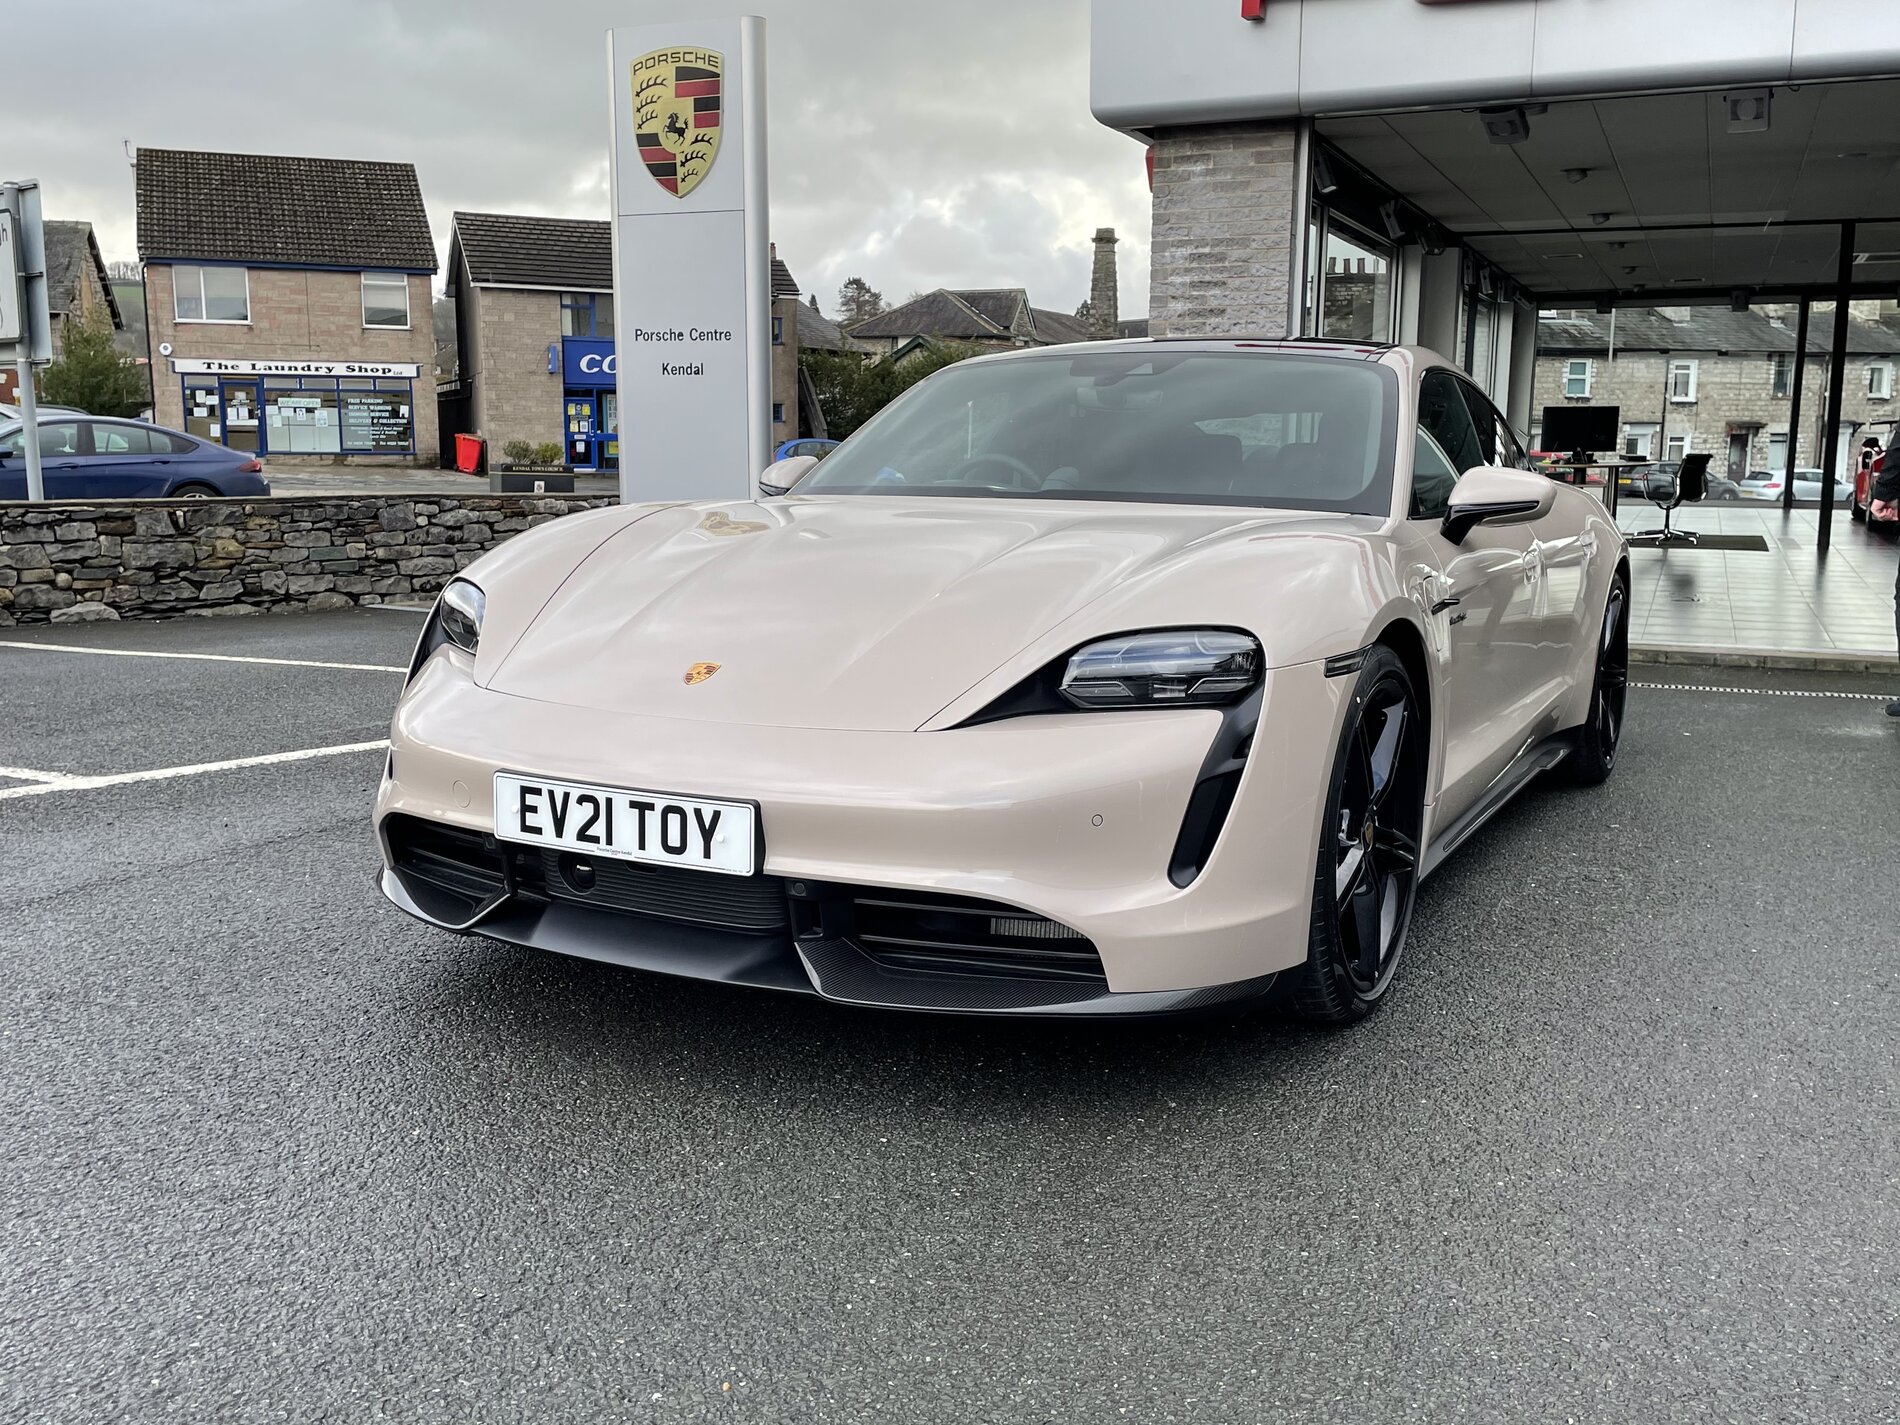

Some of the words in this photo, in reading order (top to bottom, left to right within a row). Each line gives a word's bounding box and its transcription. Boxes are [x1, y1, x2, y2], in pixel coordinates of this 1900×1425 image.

[633, 51, 719, 76] PORSCHE
[634, 328, 685, 342] Porsche
[689, 328, 732, 341] Centre
[203, 361, 240, 371] The
[250, 363, 336, 374] Laundry
[345, 365, 392, 375] Shop
[662, 363, 704, 376] Kendal
[519, 785, 613, 847] EV21
[628, 799, 722, 860] TOY
